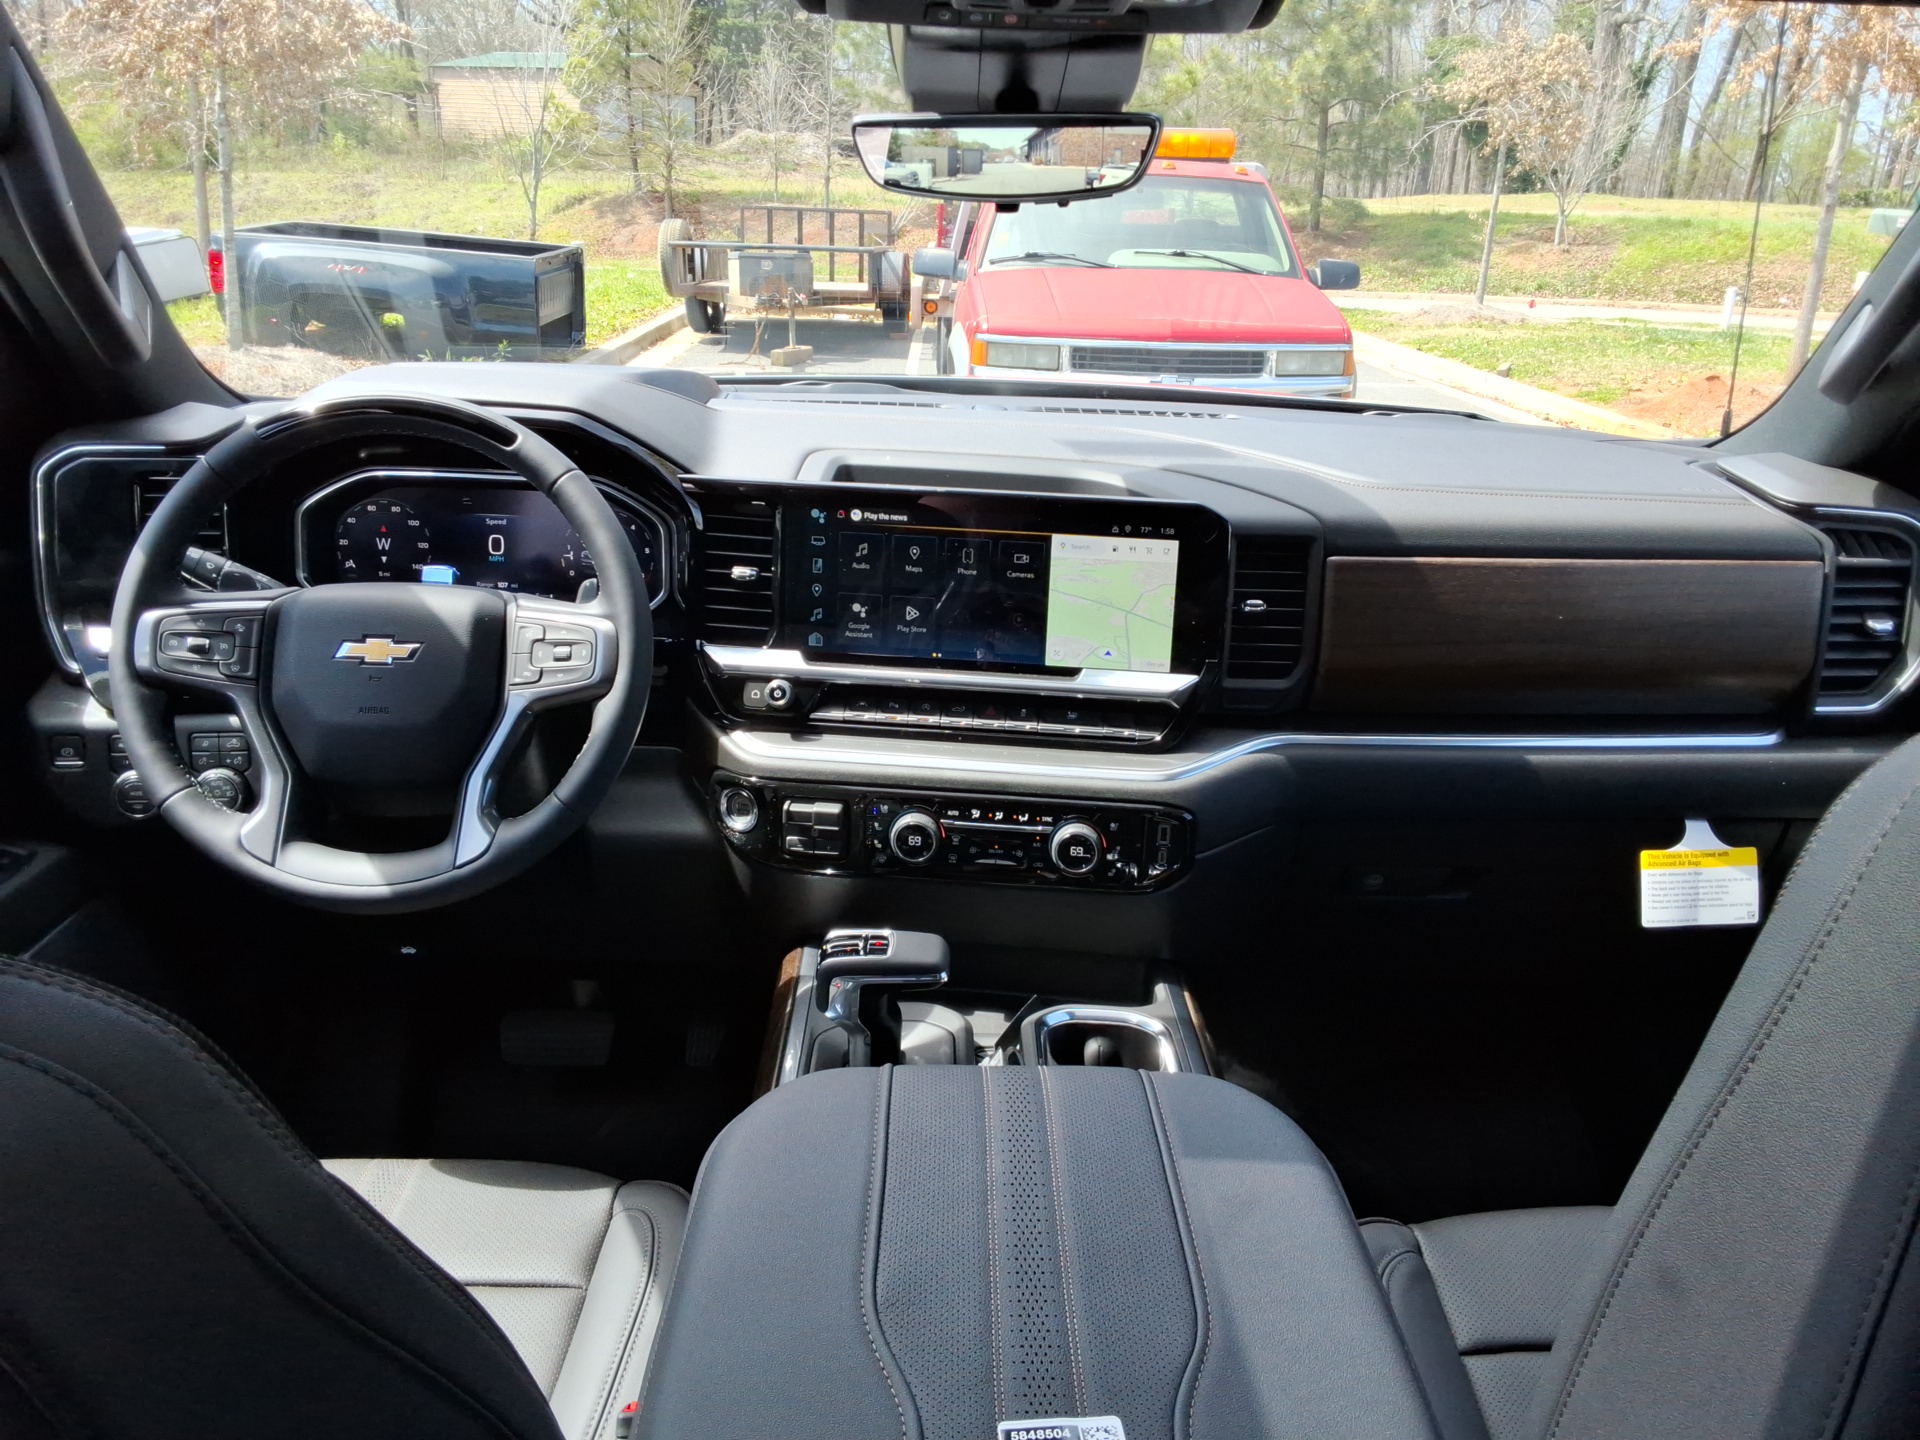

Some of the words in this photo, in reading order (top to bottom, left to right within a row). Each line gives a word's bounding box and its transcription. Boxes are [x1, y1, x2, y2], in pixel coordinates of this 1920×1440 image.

[864, 512, 878, 521] Play
[879, 512, 889, 520] the
[485, 518, 507, 526] Speed
[1160, 527, 1175, 535] 1:58
[376, 537, 391, 551] W
[488, 534, 505, 555] 0
[1070, 543, 1091, 551] Search
[851, 562, 870, 570] Audio
[905, 565, 923, 573] Maps
[957, 567, 977, 576] Phone
[1006, 570, 1035, 579] Cameras
[848, 621, 871, 631] Google
[896, 625, 910, 634] Play
[845, 630, 873, 639] Assistant
[358, 706, 390, 715] AIRBAG
[908, 835, 922, 846] 69
[1070, 846, 1084, 857] 69
[1690, 851, 1716, 859] Equipped
[1010, 1428, 1071, 1440] 5848504
